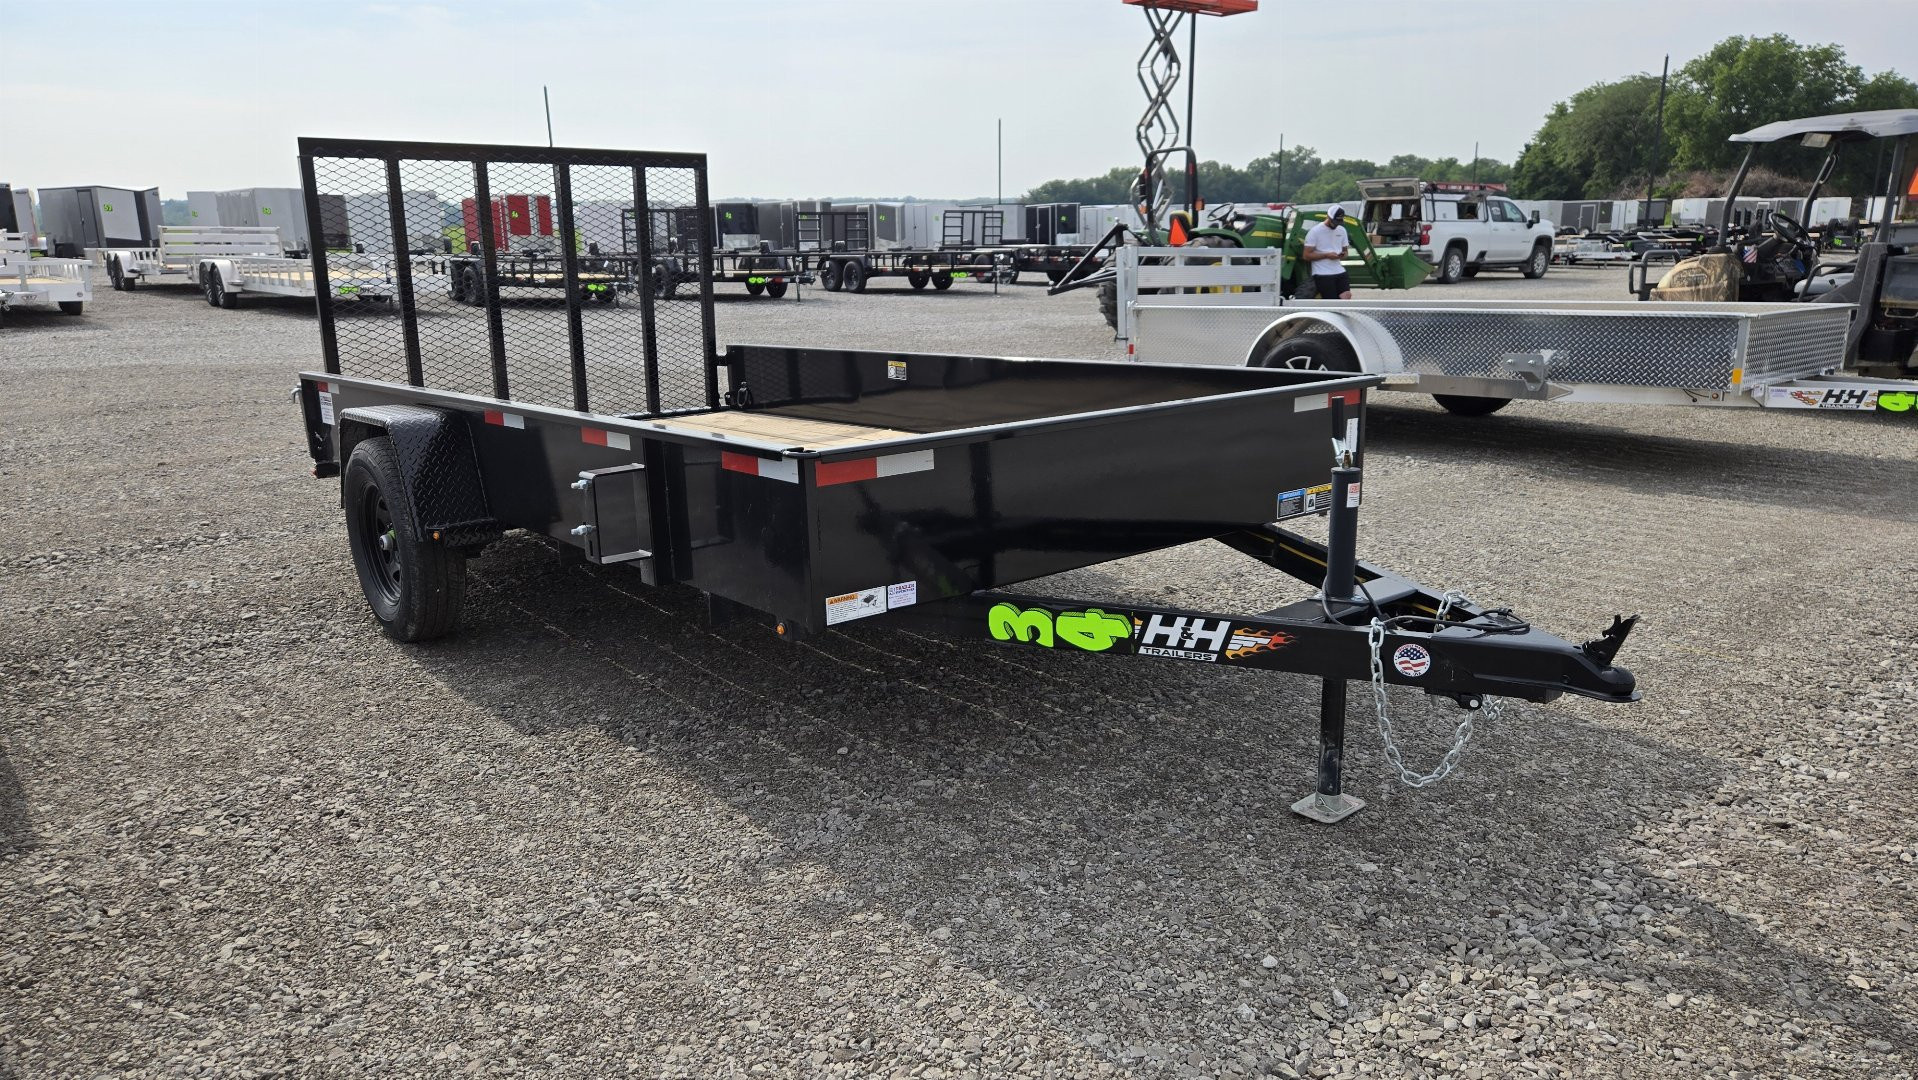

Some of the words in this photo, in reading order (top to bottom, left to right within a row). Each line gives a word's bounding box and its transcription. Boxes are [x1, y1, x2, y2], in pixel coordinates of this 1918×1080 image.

[1821, 389, 1868, 403] H&H
[1142, 614, 1231, 651] H&H
[1143, 647, 1213, 661] TRAILERS
